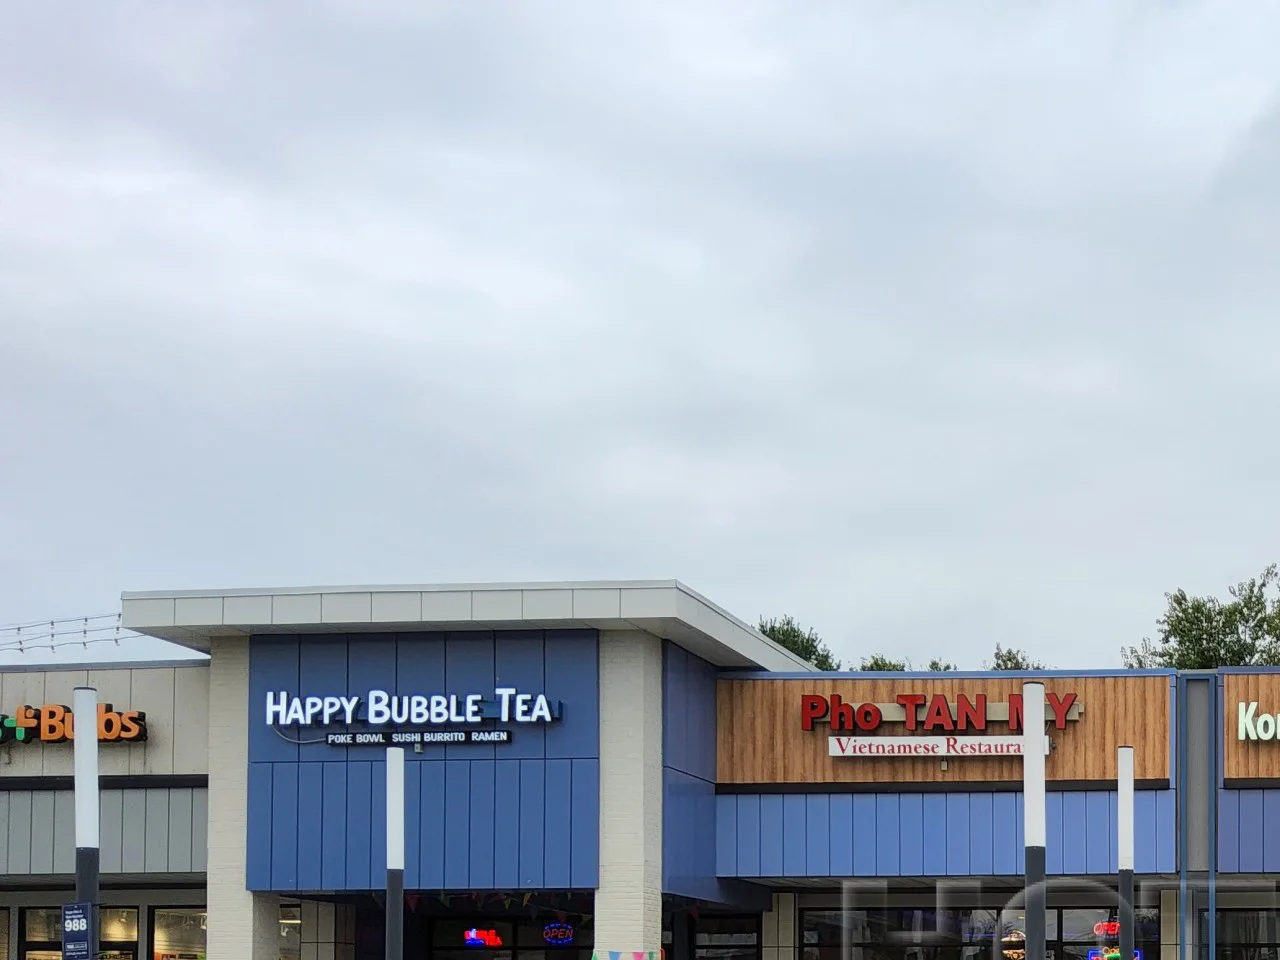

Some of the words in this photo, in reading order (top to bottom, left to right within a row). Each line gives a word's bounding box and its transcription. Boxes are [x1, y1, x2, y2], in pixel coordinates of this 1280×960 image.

[266, 691, 359, 725] HAPPY
[368, 690, 482, 724] BUBBLE
[495, 687, 552, 722] TEA
[801, 694, 883, 731] Pho
[897, 693, 987, 731] TAN
[41, 703, 140, 740] Bubs
[328, 734, 353, 744] POKE
[356, 733, 386, 743] BOWL
[392, 732, 421, 743] SUSHI
[424, 732, 465, 742] BURRITO
[471, 731, 508, 742] RAMEN
[836, 737, 940, 755] Vietnamese
[65, 918, 87, 932] 988
[543, 928, 574, 939] OPEN
